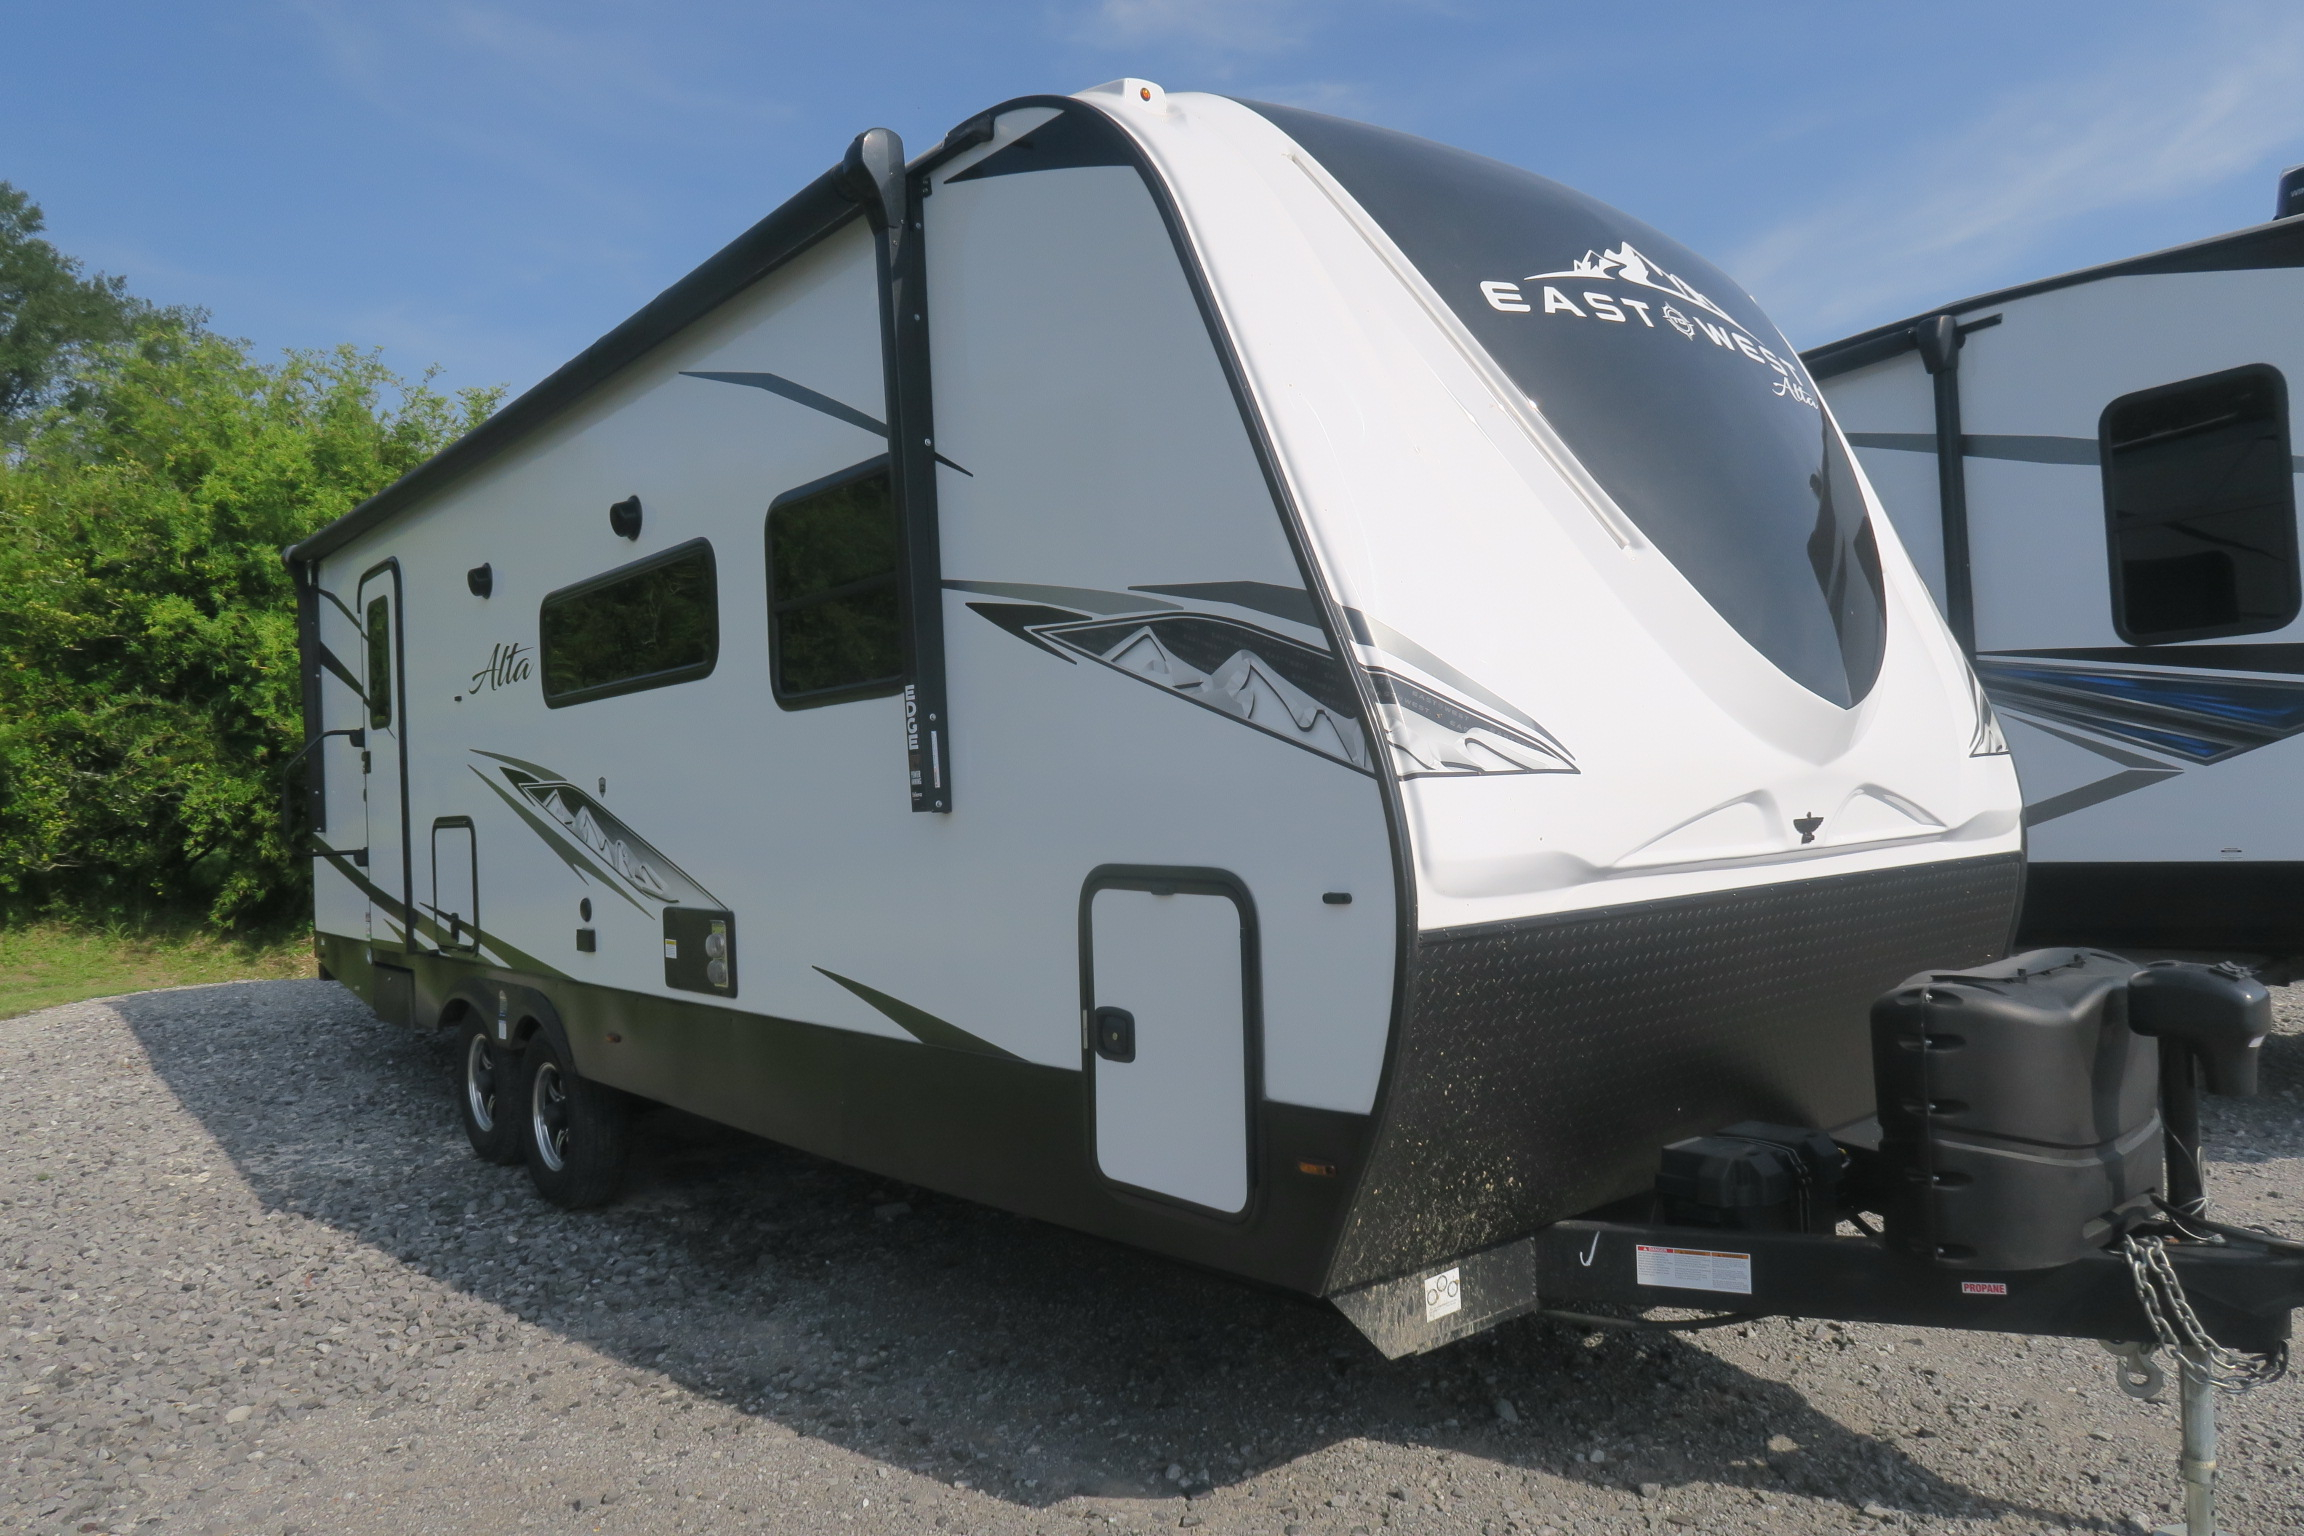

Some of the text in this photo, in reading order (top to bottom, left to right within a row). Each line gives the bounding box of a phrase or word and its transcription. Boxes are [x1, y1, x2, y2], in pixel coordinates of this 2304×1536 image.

[1480, 280, 1654, 328] EAST
[1692, 316, 1803, 386] WEST
[1771, 377, 1819, 410] Alta
[468, 642, 535, 695] Alta
[905, 684, 919, 750] EDGE
[1963, 1283, 2004, 1293] PROPANE
